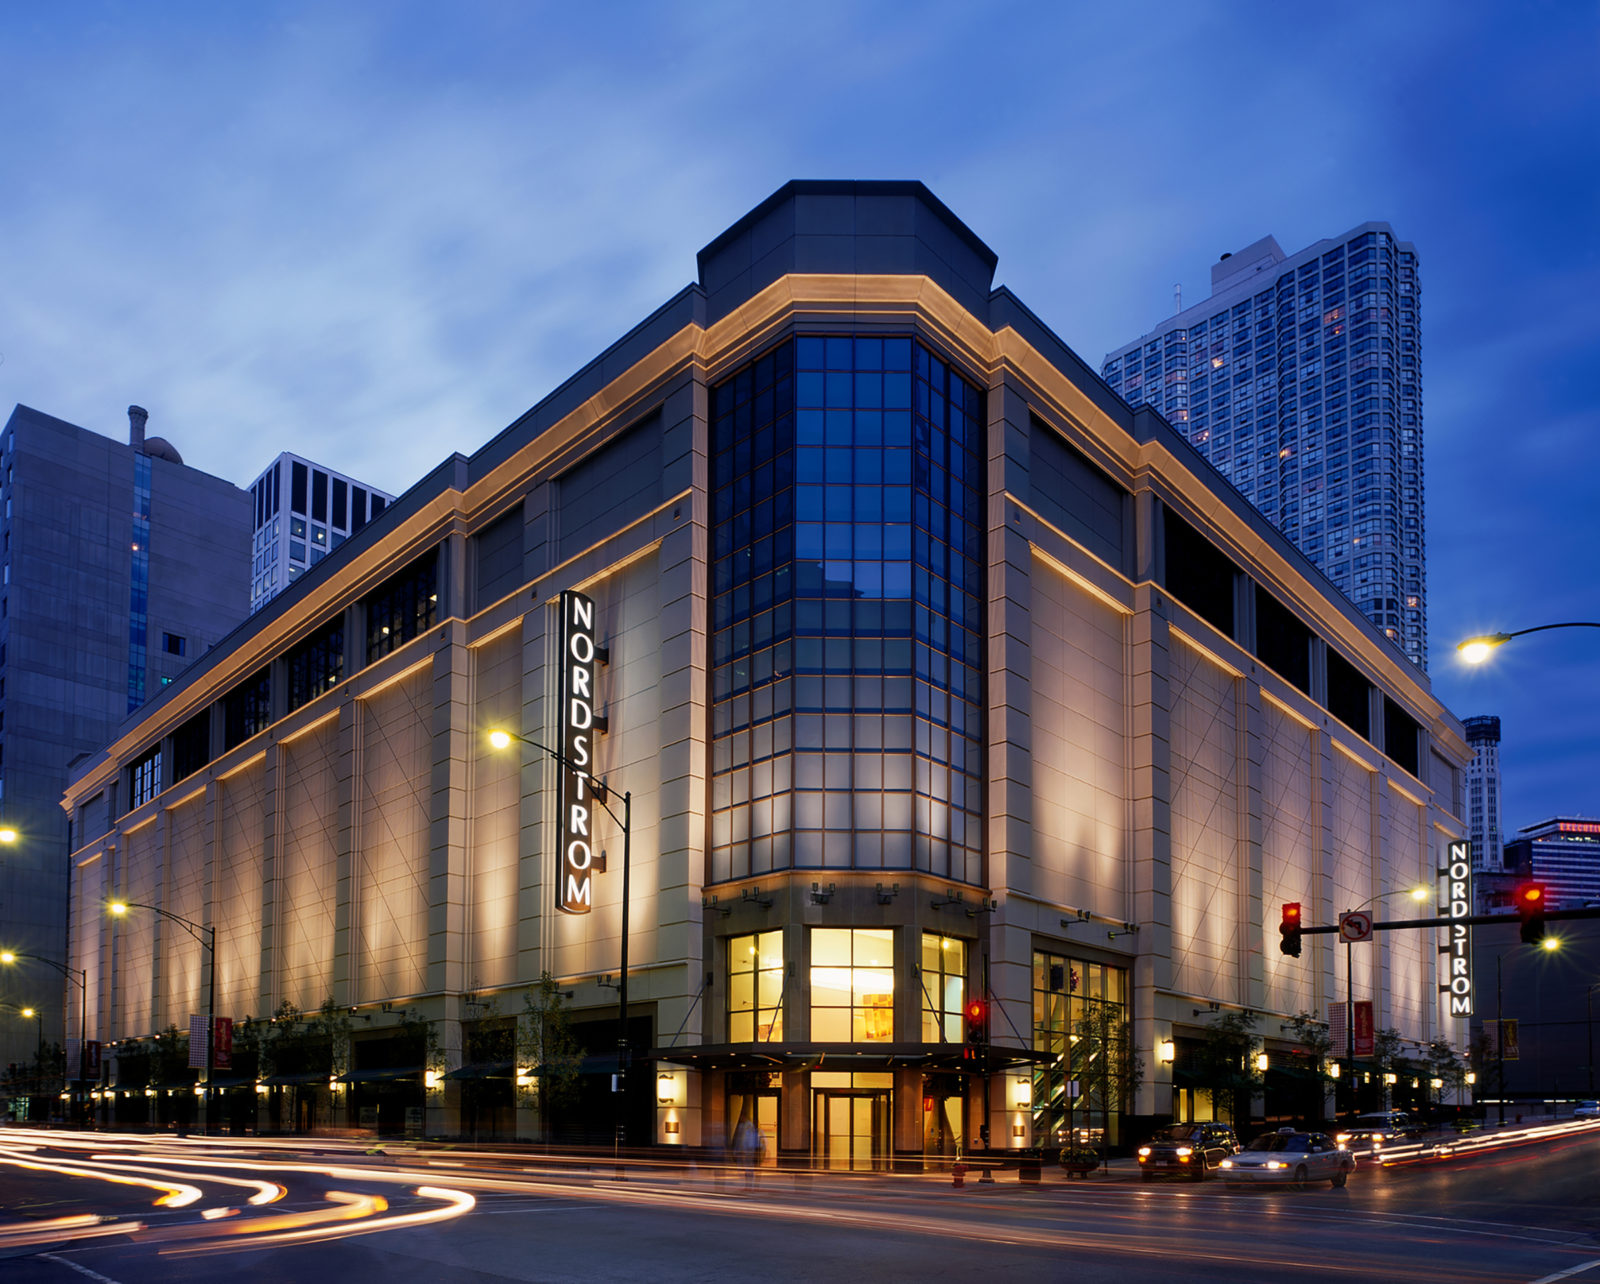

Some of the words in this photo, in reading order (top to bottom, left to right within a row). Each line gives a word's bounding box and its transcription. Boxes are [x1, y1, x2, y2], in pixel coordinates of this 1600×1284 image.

[566, 596, 594, 906] NORDSTROM
[1560, 822, 1600, 832] EXECUTI
[1450, 843, 1471, 1014] NORDSTROM
